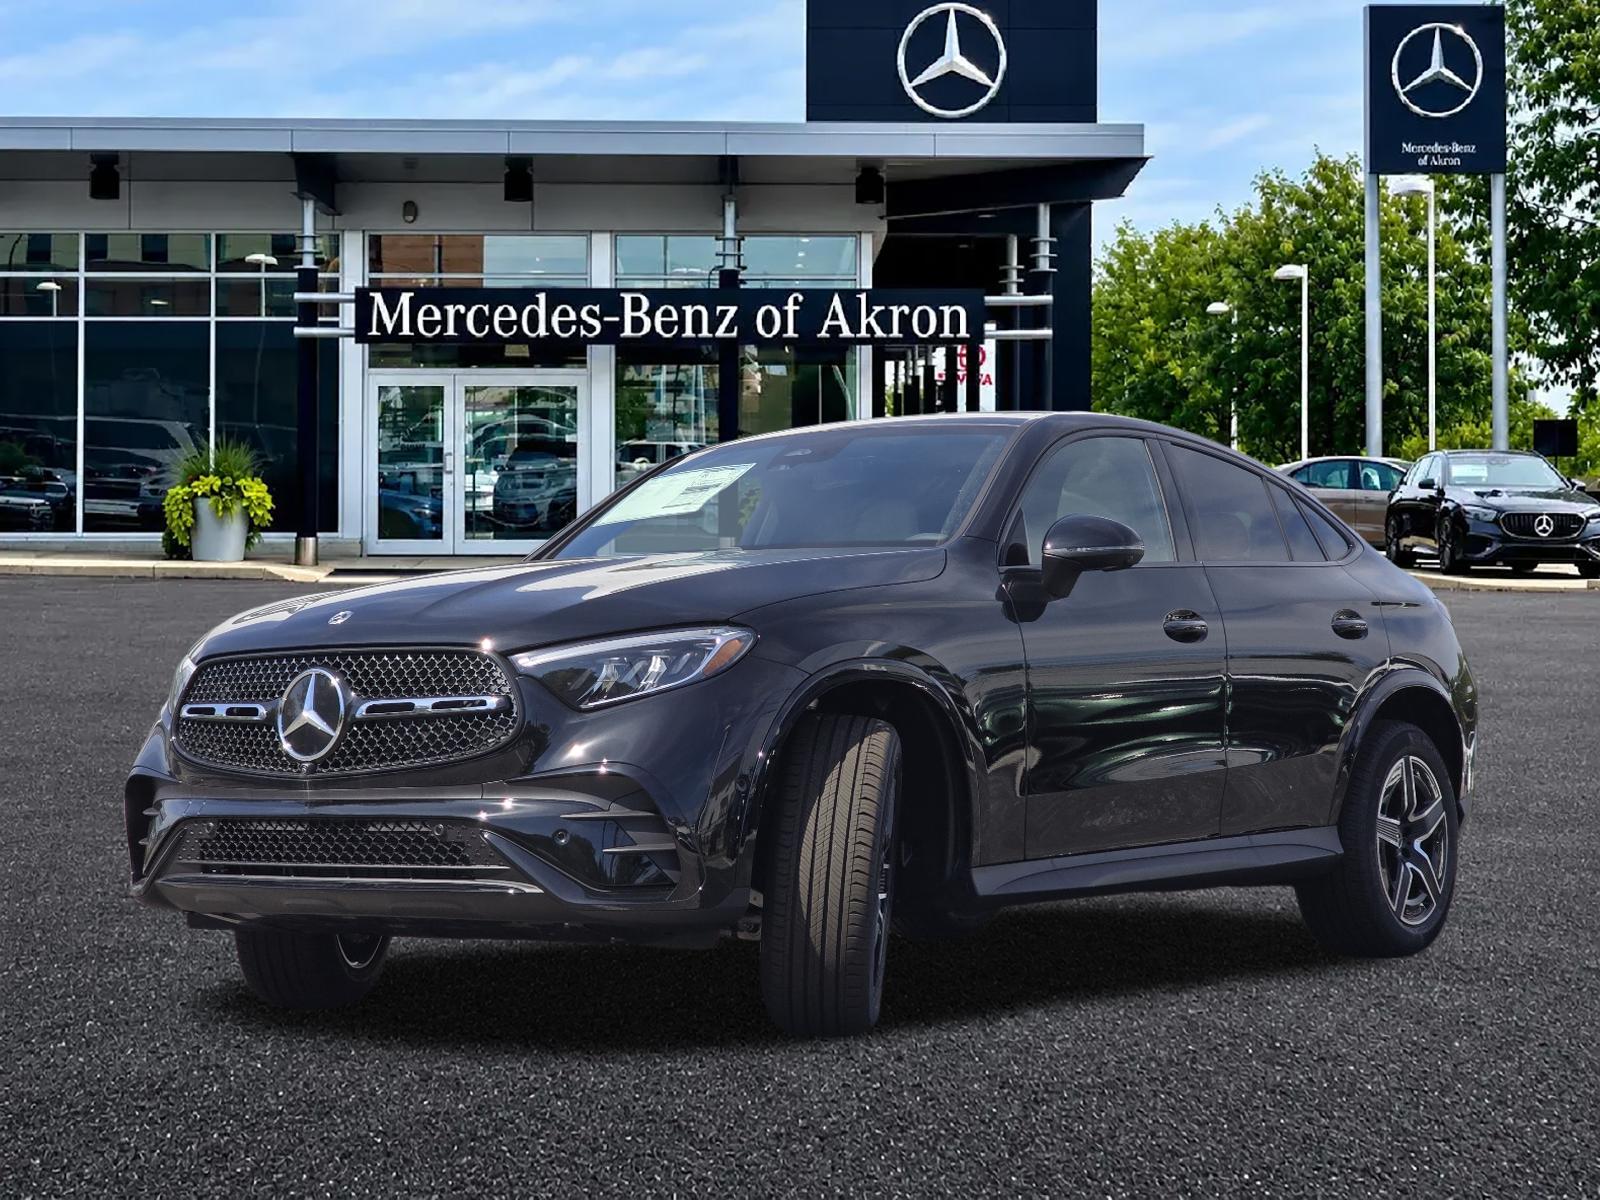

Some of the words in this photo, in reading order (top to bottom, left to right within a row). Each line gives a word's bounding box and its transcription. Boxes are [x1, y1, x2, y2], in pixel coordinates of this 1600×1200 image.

[1401, 142, 1477, 154] Mercedes-Benz
[1417, 155, 1428, 166] of
[1429, 155, 1461, 166] Akron
[367, 291, 738, 339] Mercedes-Benz
[755, 292, 804, 339] of
[816, 291, 971, 339] Akron
